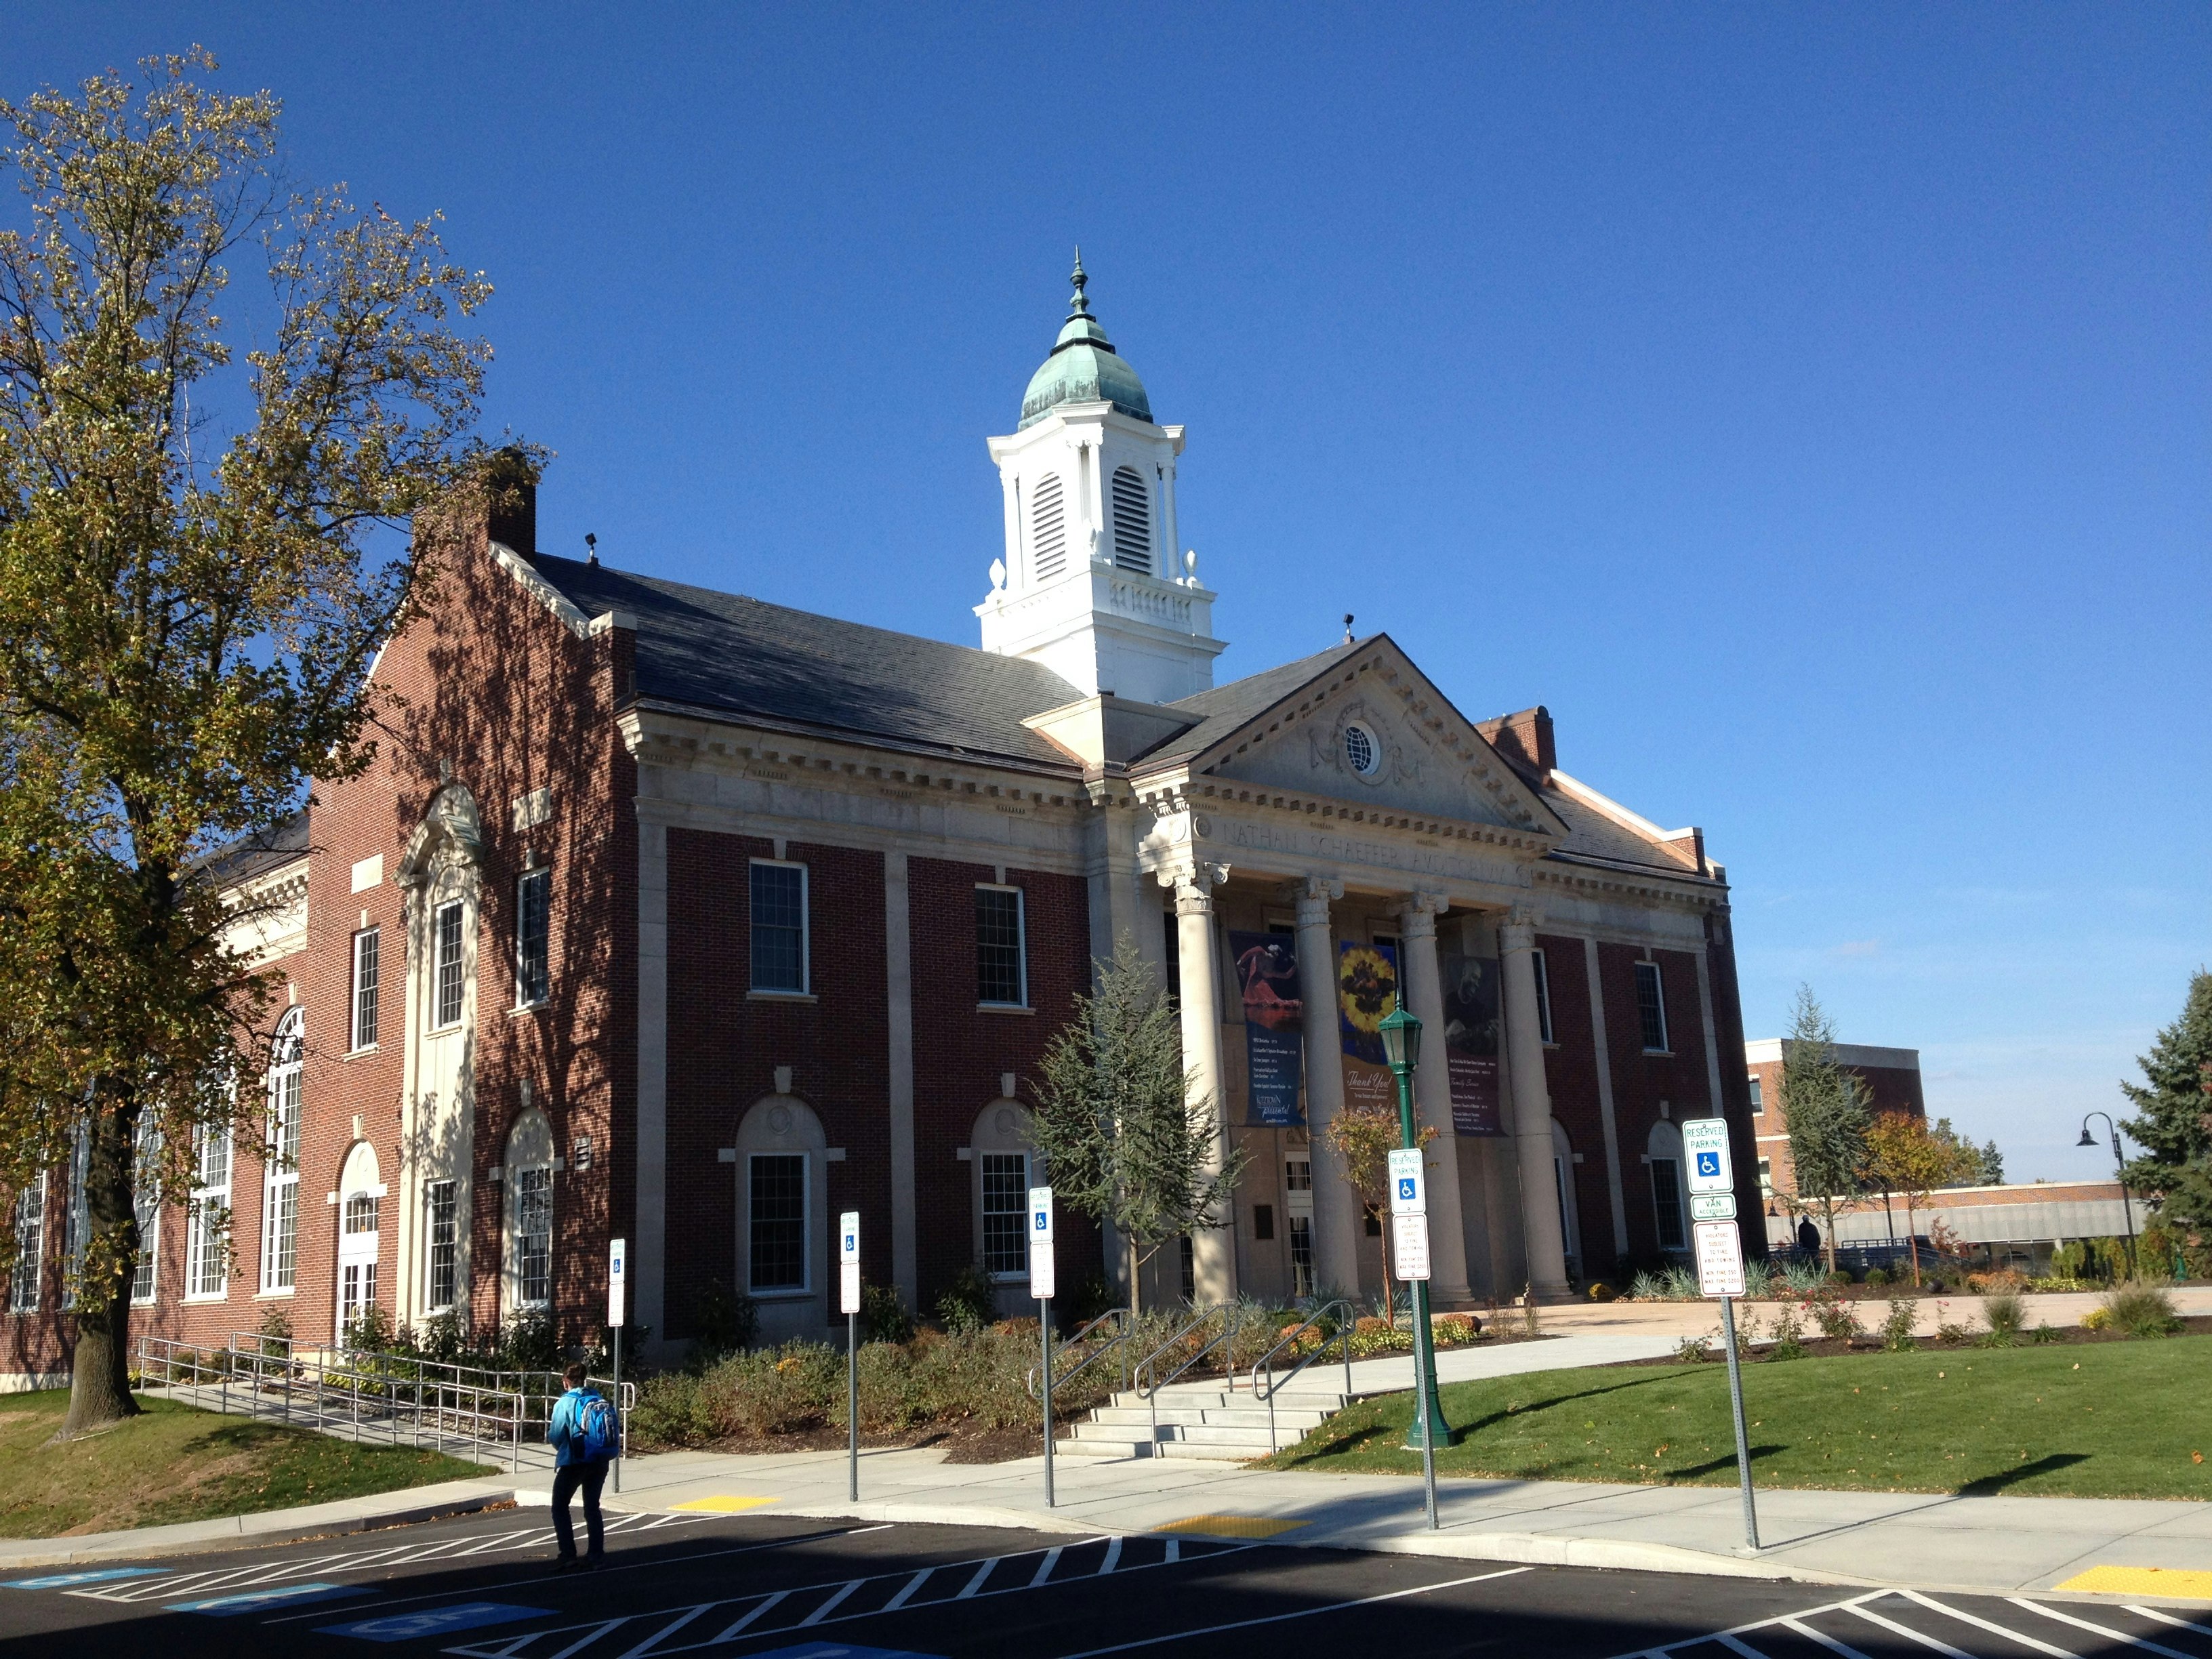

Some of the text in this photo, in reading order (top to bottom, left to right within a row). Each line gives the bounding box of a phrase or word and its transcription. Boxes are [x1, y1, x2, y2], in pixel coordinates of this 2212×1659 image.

[1224, 822, 1297, 850] NATHAN
[1311, 835, 1399, 866] SCHAEFFER
[1347, 1071, 1393, 1094] Thank You!
[1687, 1126, 1723, 1137] RESERVED
[1691, 1139, 1723, 1149] PARKING
[1391, 1156, 1420, 1165] RESERVED
